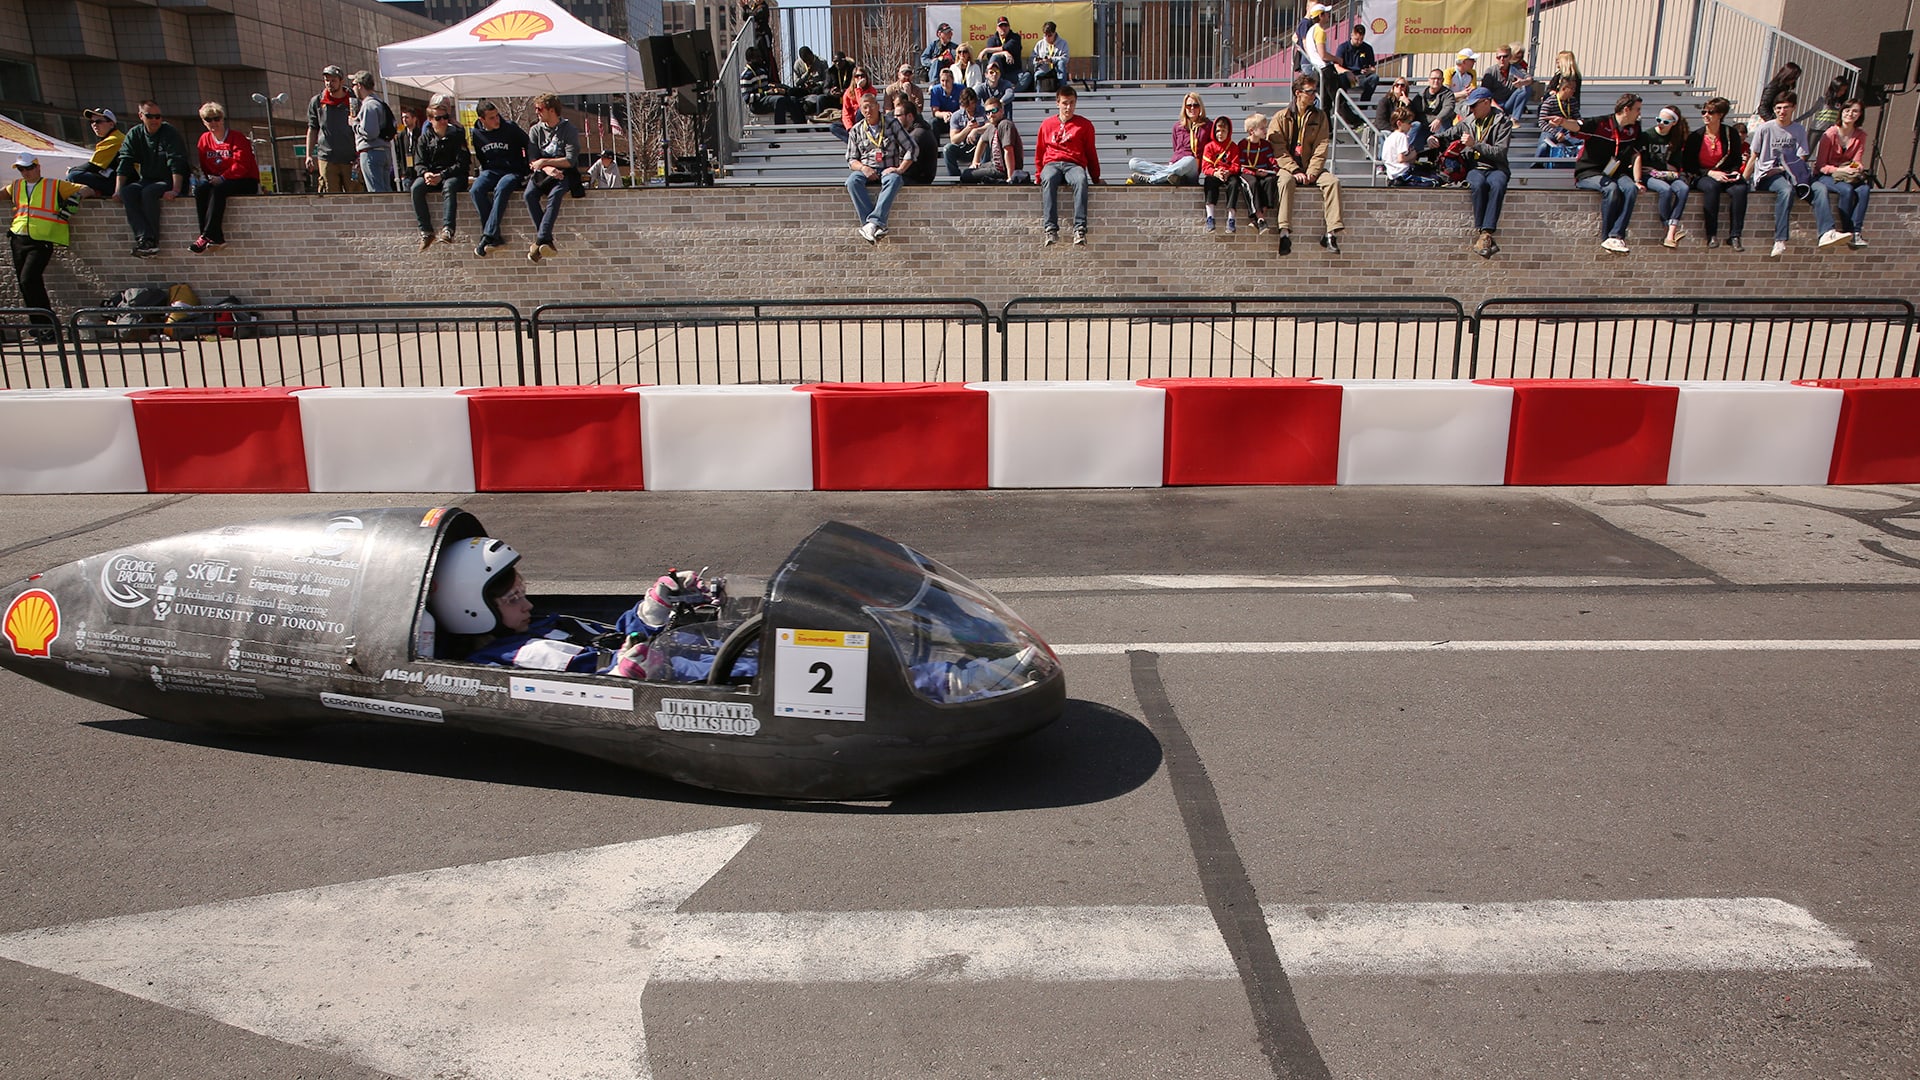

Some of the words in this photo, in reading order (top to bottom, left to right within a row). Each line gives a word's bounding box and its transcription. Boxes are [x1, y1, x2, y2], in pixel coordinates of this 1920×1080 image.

[1404, 25, 1472, 34] Eco-marathon
[115, 558, 157, 572] GEORGE
[117, 570, 157, 583] BROWN
[252, 565, 298, 583] University
[300, 572, 311, 582] of
[314, 572, 350, 587] Toronto
[248, 578, 299, 595] Engineering
[299, 584, 332, 597] Alumni
[178, 588, 225, 603] Mechanical
[225, 593, 234, 604] &
[235, 594, 276, 609] Industrial
[277, 599, 329, 618] Engineering
[174, 603, 254, 623] UNIVERSITY
[258, 613, 276, 625] OF
[280, 616, 345, 634] TORONTO
[87, 631, 130, 643] UNIVERSITY
[131, 636, 142, 644] OF
[143, 637, 177, 648] TORONTO
[241, 651, 289, 664] UNIVERSITY
[290, 657, 302, 665] OF
[303, 659, 342, 671] TORONTO
[381, 669, 423, 683] MSM
[808, 662, 833, 694] 2
[322, 697, 385, 711] CERAMTECH
[388, 706, 442, 719] COATINGS
[663, 701, 752, 718] ULTIMATE
[658, 714, 758, 734] WORKSHOP
